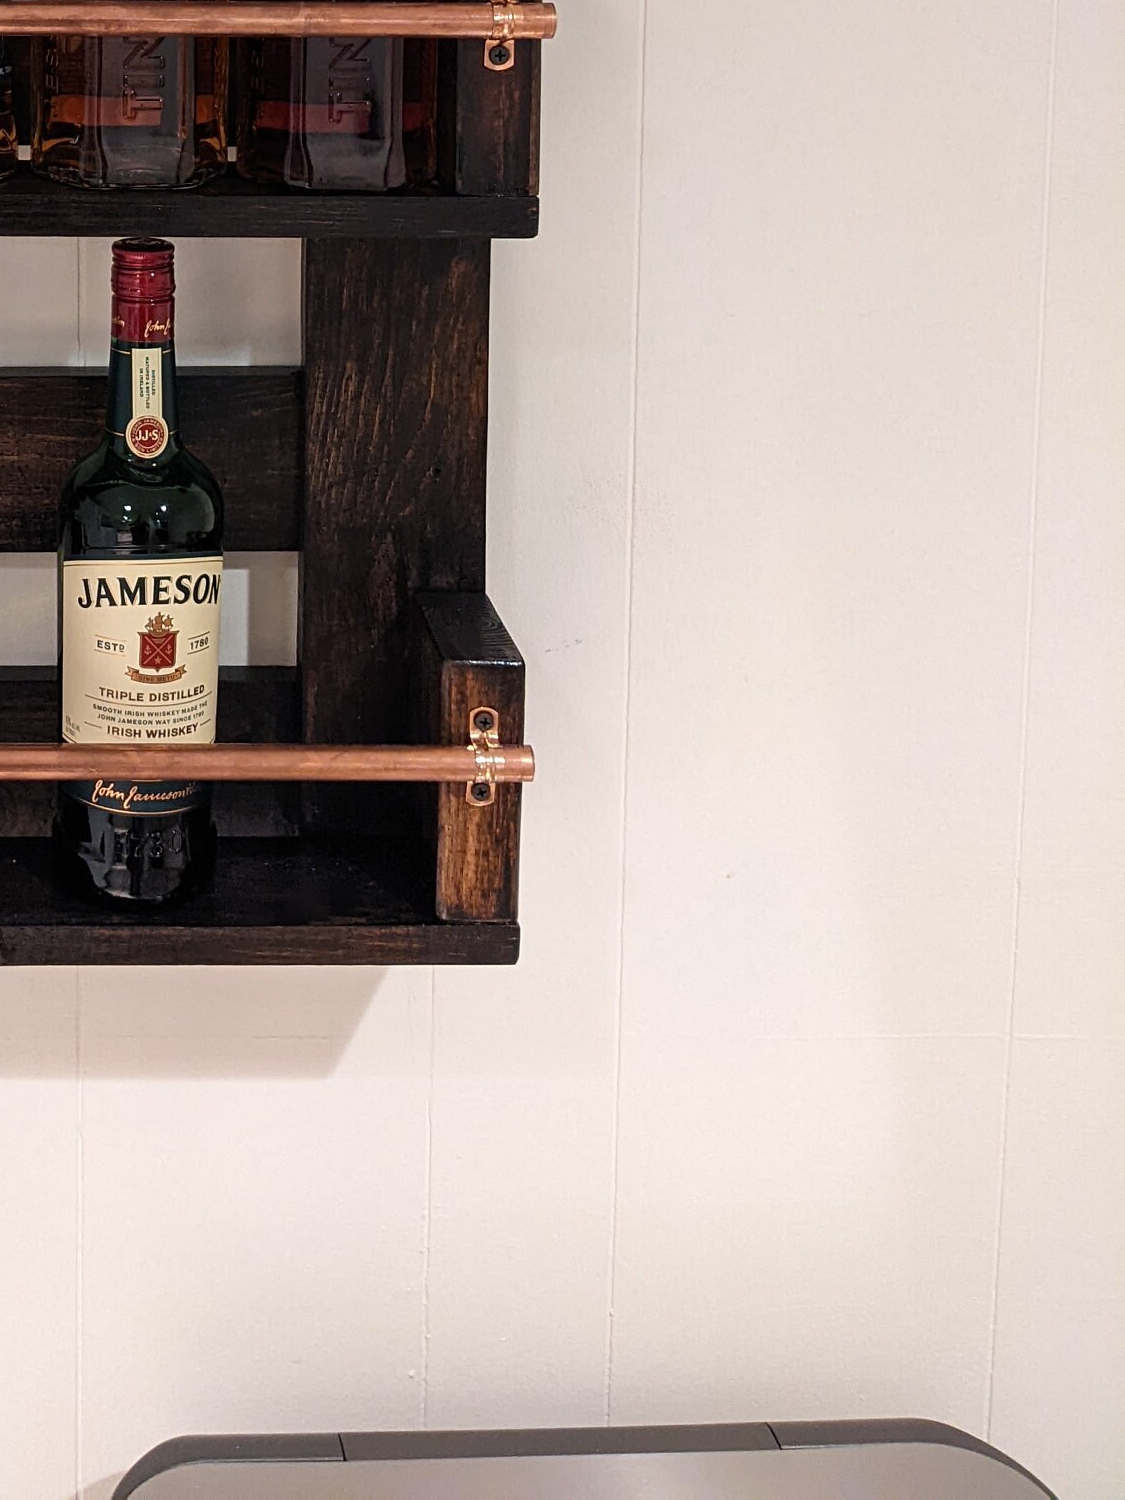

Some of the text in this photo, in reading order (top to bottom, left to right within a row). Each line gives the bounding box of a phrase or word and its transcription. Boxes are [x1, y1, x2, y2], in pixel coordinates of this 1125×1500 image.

[144, 319, 165, 338] John
[135, 429, 159, 441] JJ&S
[78, 573, 221, 609] JAMESON
[96, 636, 209, 653] ESTD 1780
[98, 684, 205, 702] TRIPLE DISTILLED
[92, 703, 123, 715] SMOOTH
[147, 709, 180, 717] WHISKEY
[181, 705, 198, 714] MADE
[199, 700, 208, 709] THE
[97, 713, 115, 722] JOHN
[118, 717, 153, 725] JAMESON
[172, 715, 191, 724] SINCE
[193, 710, 205, 719] 1780
[107, 722, 199, 739] IRISH WHISKEY
[91, 779, 124, 803] John
[123, 785, 186, 809] Jameson
